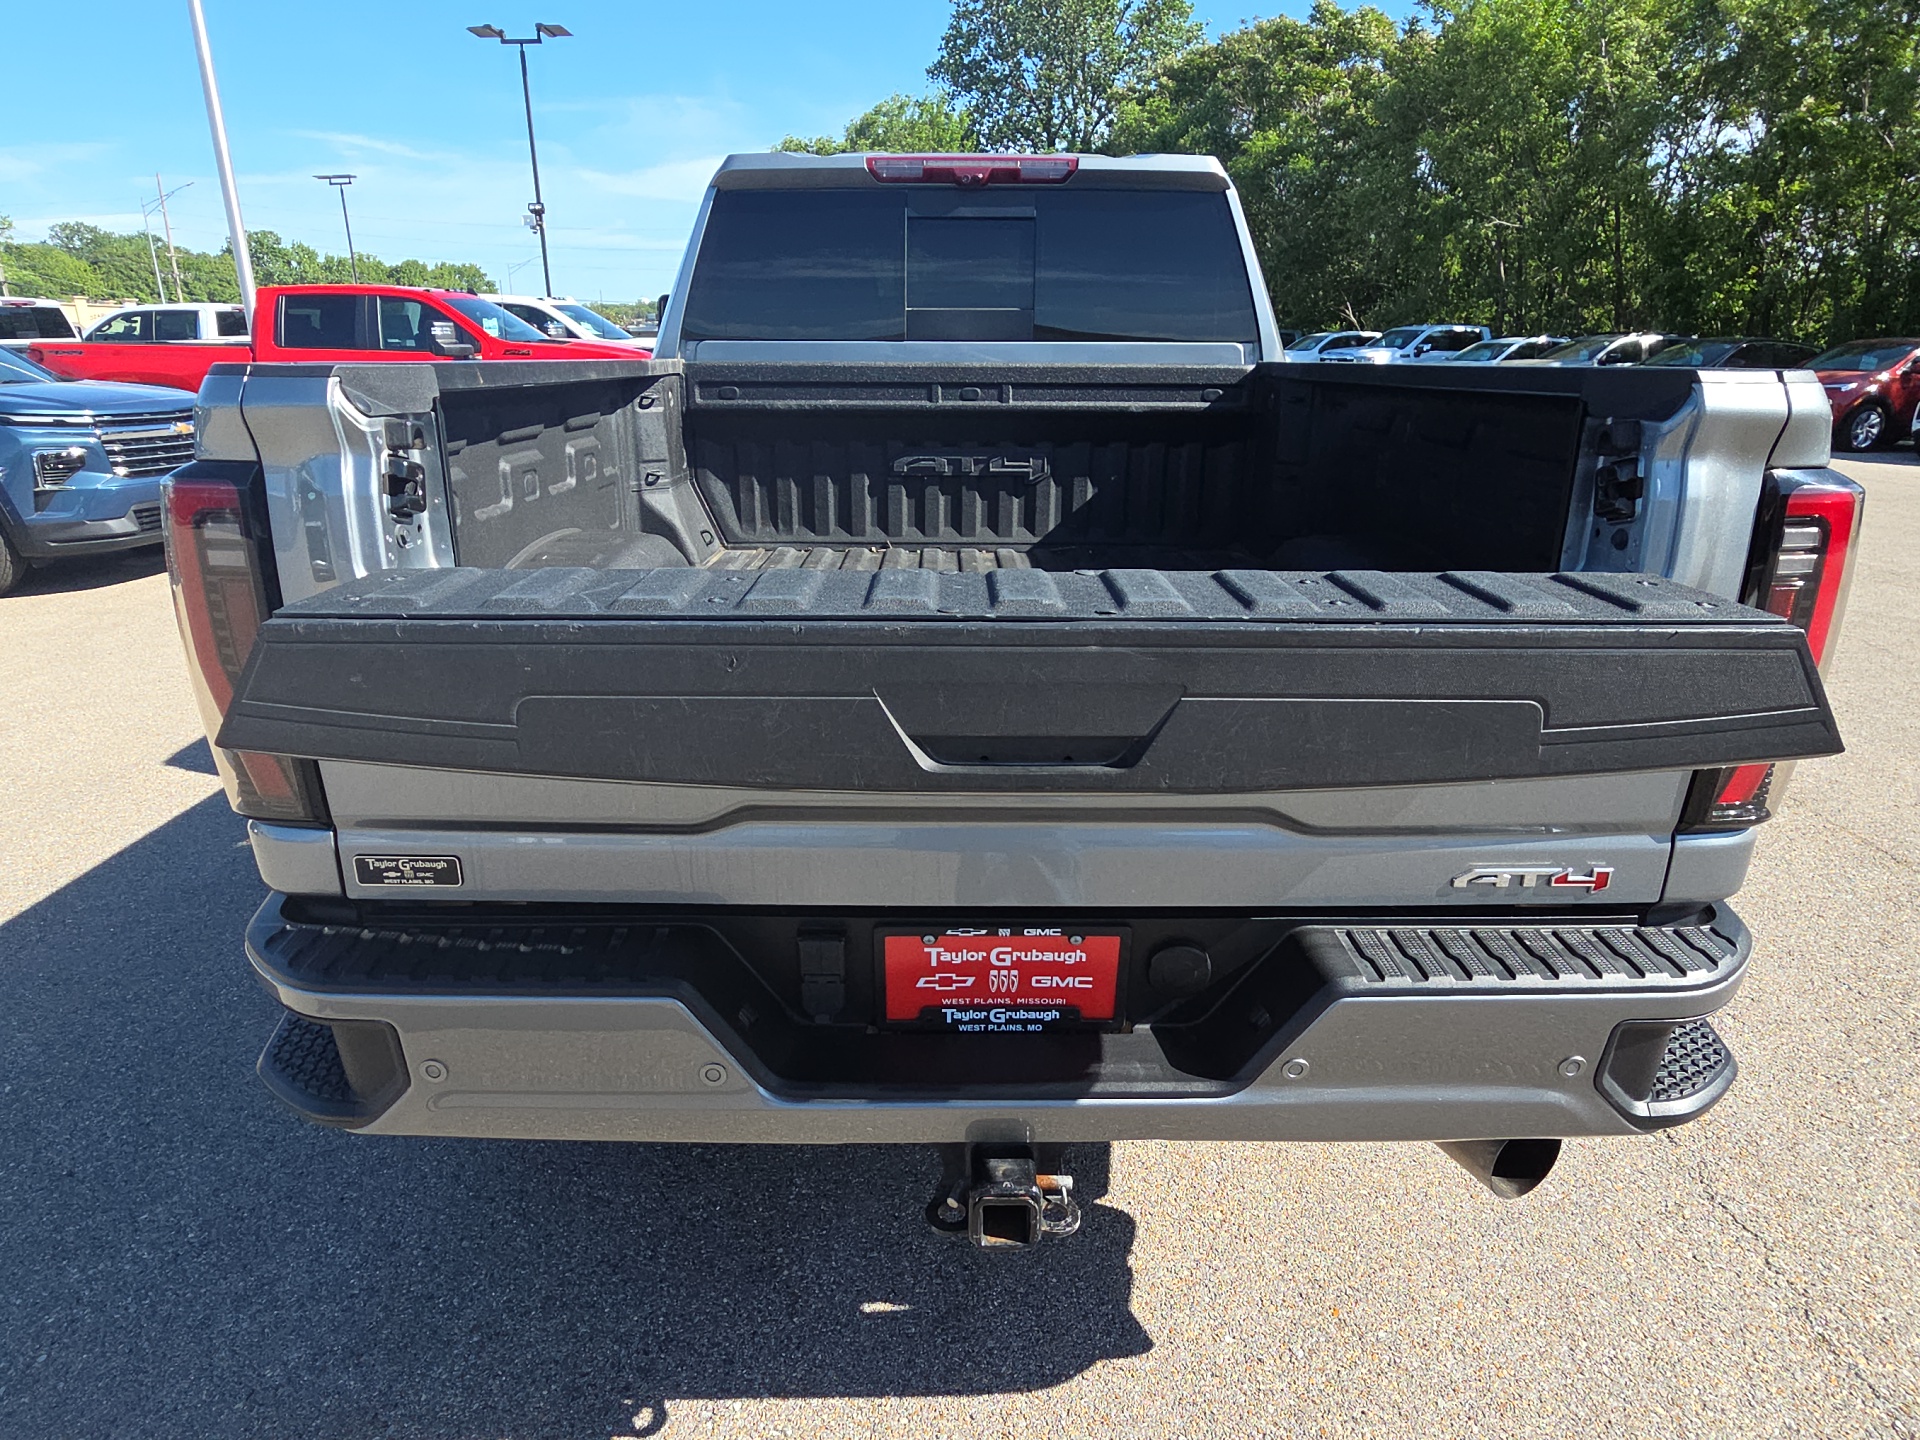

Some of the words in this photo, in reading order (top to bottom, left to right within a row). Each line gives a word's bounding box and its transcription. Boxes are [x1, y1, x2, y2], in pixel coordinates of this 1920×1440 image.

[893, 456, 1050, 480] AT4
[365, 859, 397, 870] Taylor
[398, 859, 447, 871] Grubaugh
[1451, 867, 1615, 894] AT4
[1023, 928, 1062, 936] GMC
[924, 947, 987, 967] Taylor
[989, 947, 1087, 966] Grubaugh
[1031, 976, 1093, 988] GMC
[941, 1008, 988, 1024] Taylor
[989, 1008, 1060, 1023] Grubaugh
[958, 1024, 986, 1032] WEST
[1026, 1024, 1043, 1032] MO
